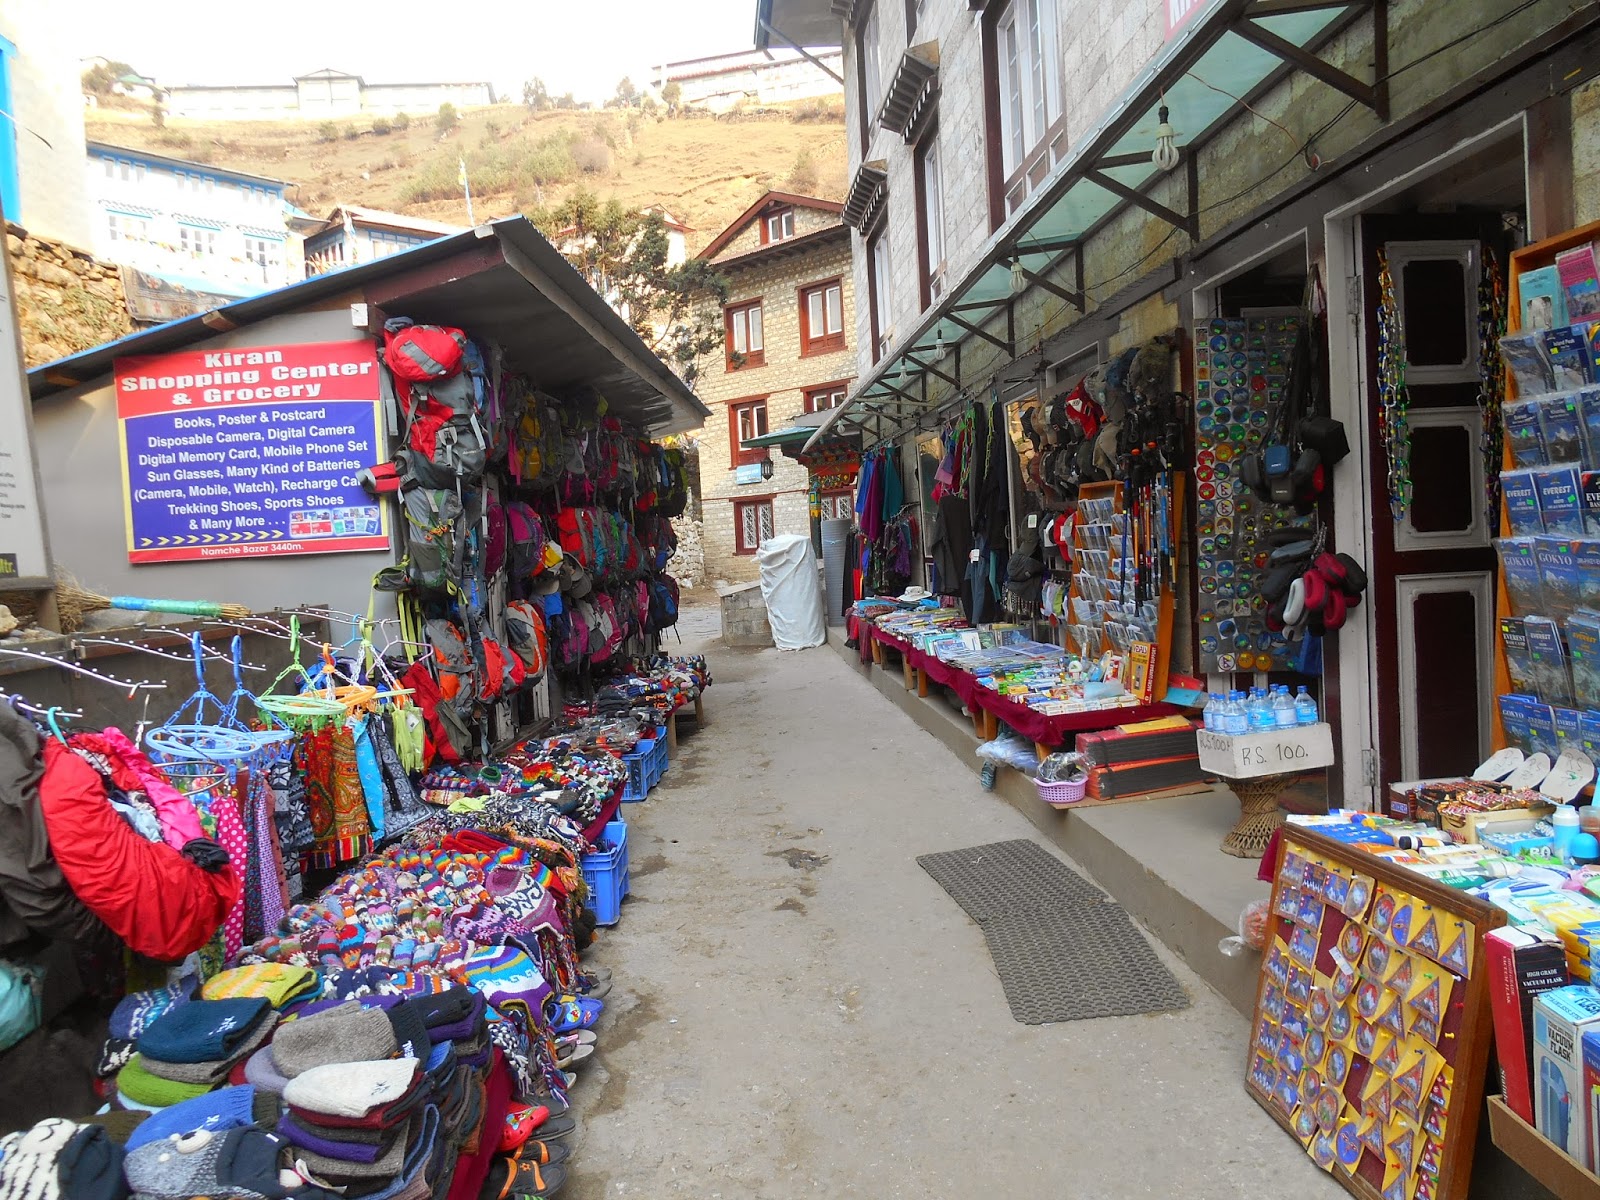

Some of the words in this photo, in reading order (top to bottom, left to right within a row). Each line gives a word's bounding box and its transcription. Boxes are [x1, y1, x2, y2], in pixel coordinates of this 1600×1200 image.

[204, 350, 283, 368] Kiran
[121, 370, 260, 391] Shopping
[271, 362, 372, 380] Center
[172, 393, 192, 405] &
[203, 383, 321, 402] Grocery
[174, 416, 215, 429] Books,
[218, 413, 257, 425] Poster
[260, 411, 269, 423] &
[272, 408, 326, 422] Postcard
[148, 432, 213, 449] Disposable
[216, 430, 265, 443] Camera,
[267, 427, 306, 441] Digital
[309, 425, 355, 437] Camera
[138, 453, 176, 467] Digital
[178, 451, 225, 464] Memory
[228, 447, 261, 460] Card,
[263, 445, 303, 457] Mobile
[306, 442, 345, 454] Phone
[347, 440, 368, 451] Set
[147, 471, 171, 482] Sun
[173, 468, 224, 480] Glasses,
[226, 466, 258, 478] Many
[261, 463, 289, 475] Kind
[292, 461, 304, 473] of
[307, 458, 361, 471] Batteries
[134, 489, 186, 503] (Camera,
[188, 484, 231, 497] Mobile,
[234, 480, 278, 494] Watch),
[281, 477, 338, 490] Recharge
[1506, 489, 1531, 498] EVEREST
[1543, 485, 1571, 495] EVEREST
[168, 503, 218, 515] Trekking
[221, 500, 261, 512] Shoes,
[264, 498, 303, 510] Sports
[306, 495, 344, 507] Shoes
[189, 519, 198, 530] &
[201, 518, 232, 530] Many
[235, 516, 265, 527] More
[201, 547, 241, 556] Namche
[243, 545, 268, 553] Bazar
[271, 543, 304, 551] 3440m.
[1538, 553, 1572, 565] GOKYO
[1504, 556, 1533, 566] GOKYO
[1522, 978, 1546, 987] VACUUM
[1546, 976, 1563, 985] FLASK
[1526, 970, 1540, 978] HIGH
[1540, 968, 1558, 977] GRADE
[1547, 1026, 1574, 1053] VACUUM
[1550, 1041, 1572, 1062] FLASK
